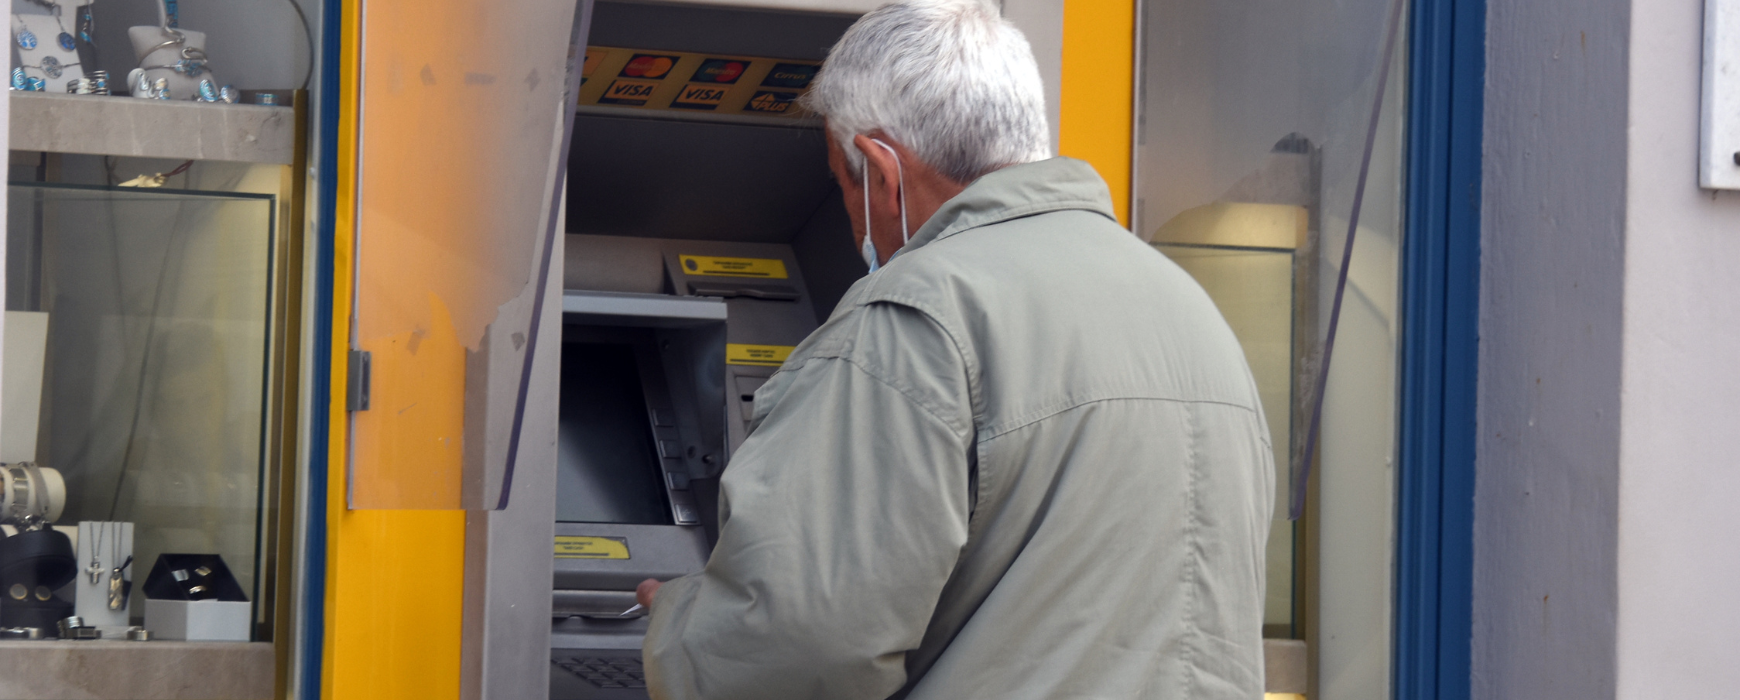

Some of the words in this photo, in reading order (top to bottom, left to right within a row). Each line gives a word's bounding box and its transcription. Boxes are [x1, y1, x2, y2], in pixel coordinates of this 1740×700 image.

[774, 71, 807, 80] Cirrus
[614, 84, 652, 98] VISA
[685, 88, 724, 101] VISA
[757, 102, 790, 113] PLUS
